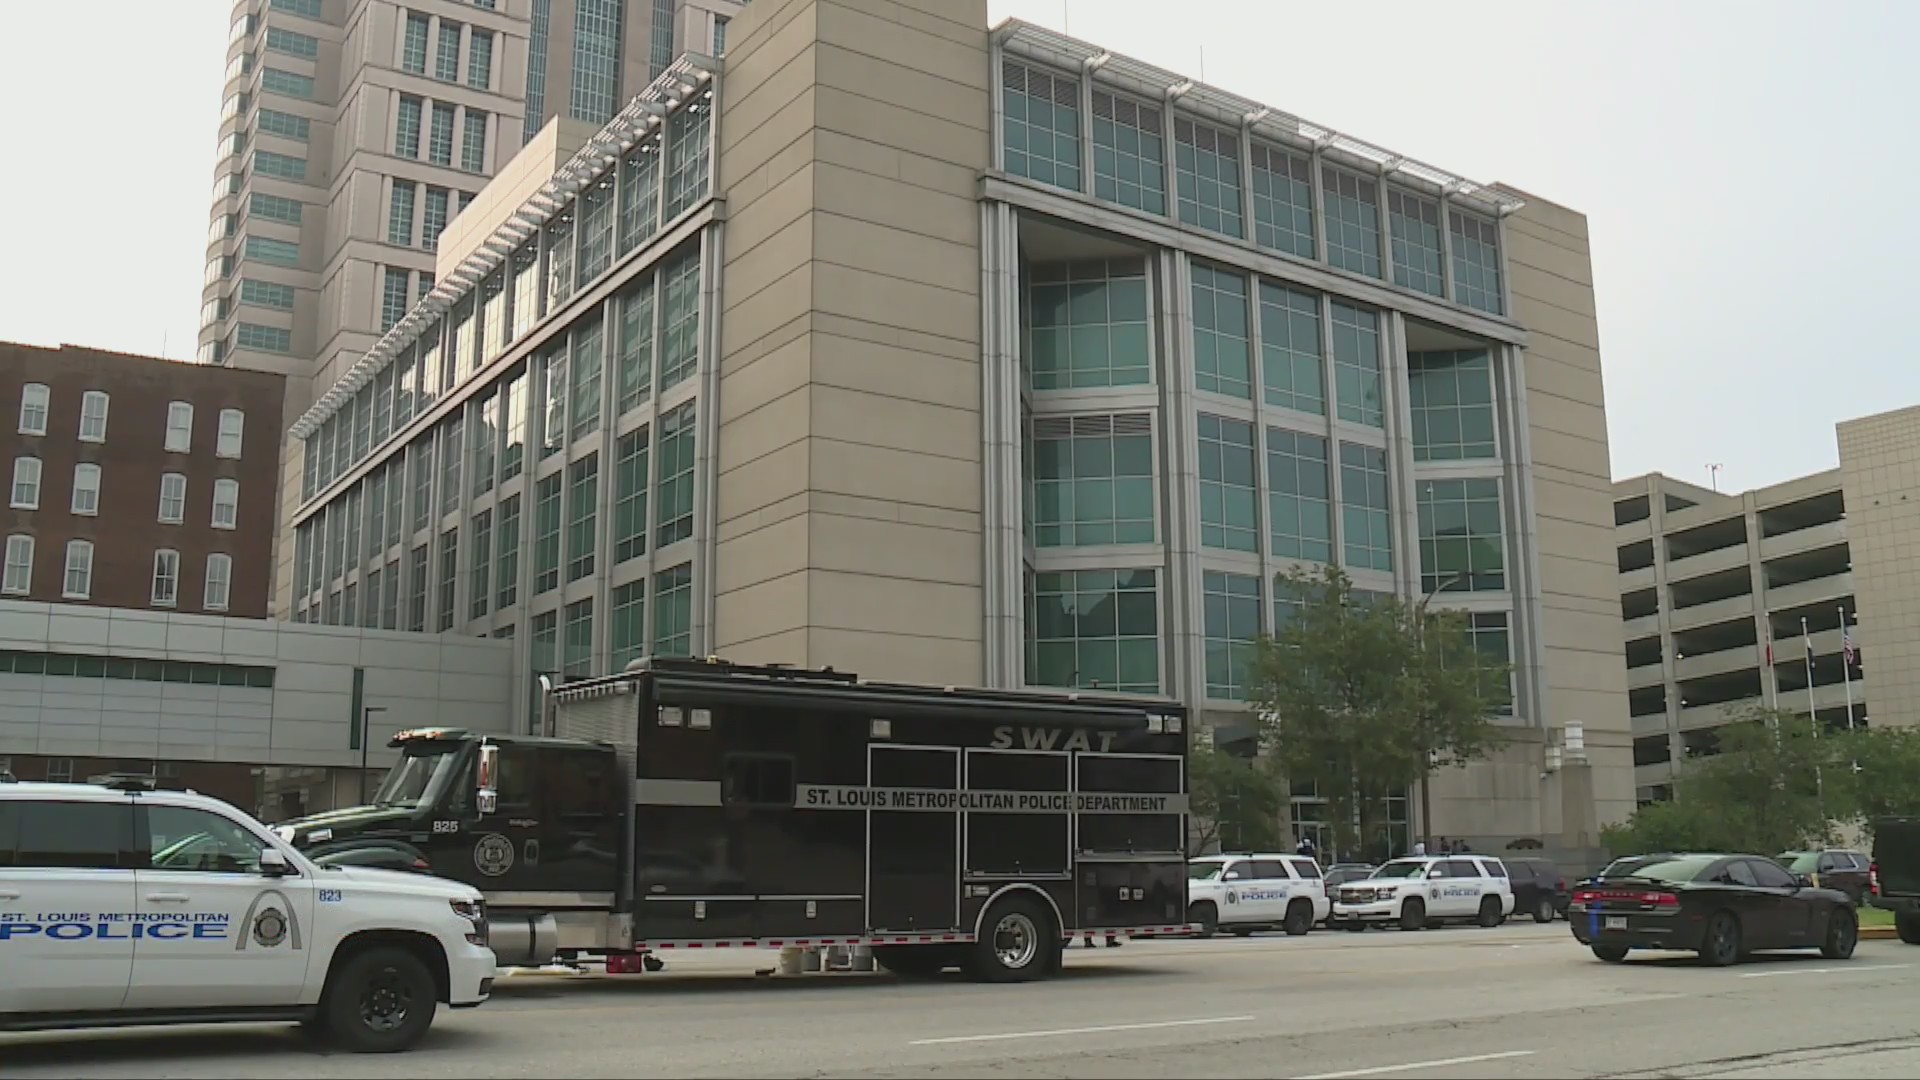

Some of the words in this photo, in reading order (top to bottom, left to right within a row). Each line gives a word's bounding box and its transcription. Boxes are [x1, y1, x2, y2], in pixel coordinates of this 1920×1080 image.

[990, 727, 1117, 752] SWAT
[807, 788, 832, 805] ST.
[837, 789, 887, 807] LOUIS
[892, 791, 1014, 809] METROPOLITAN
[1019, 794, 1072, 810] POLICE
[1076, 796, 1166, 812] DEPARTMENT
[433, 820, 459, 833] 825
[318, 889, 342, 902] 823
[1, 912, 30, 923] ST.
[37, 912, 91, 923] LOUIS
[98, 912, 229, 923] METROPOLITAN
[0, 922, 229, 940] POLICE
